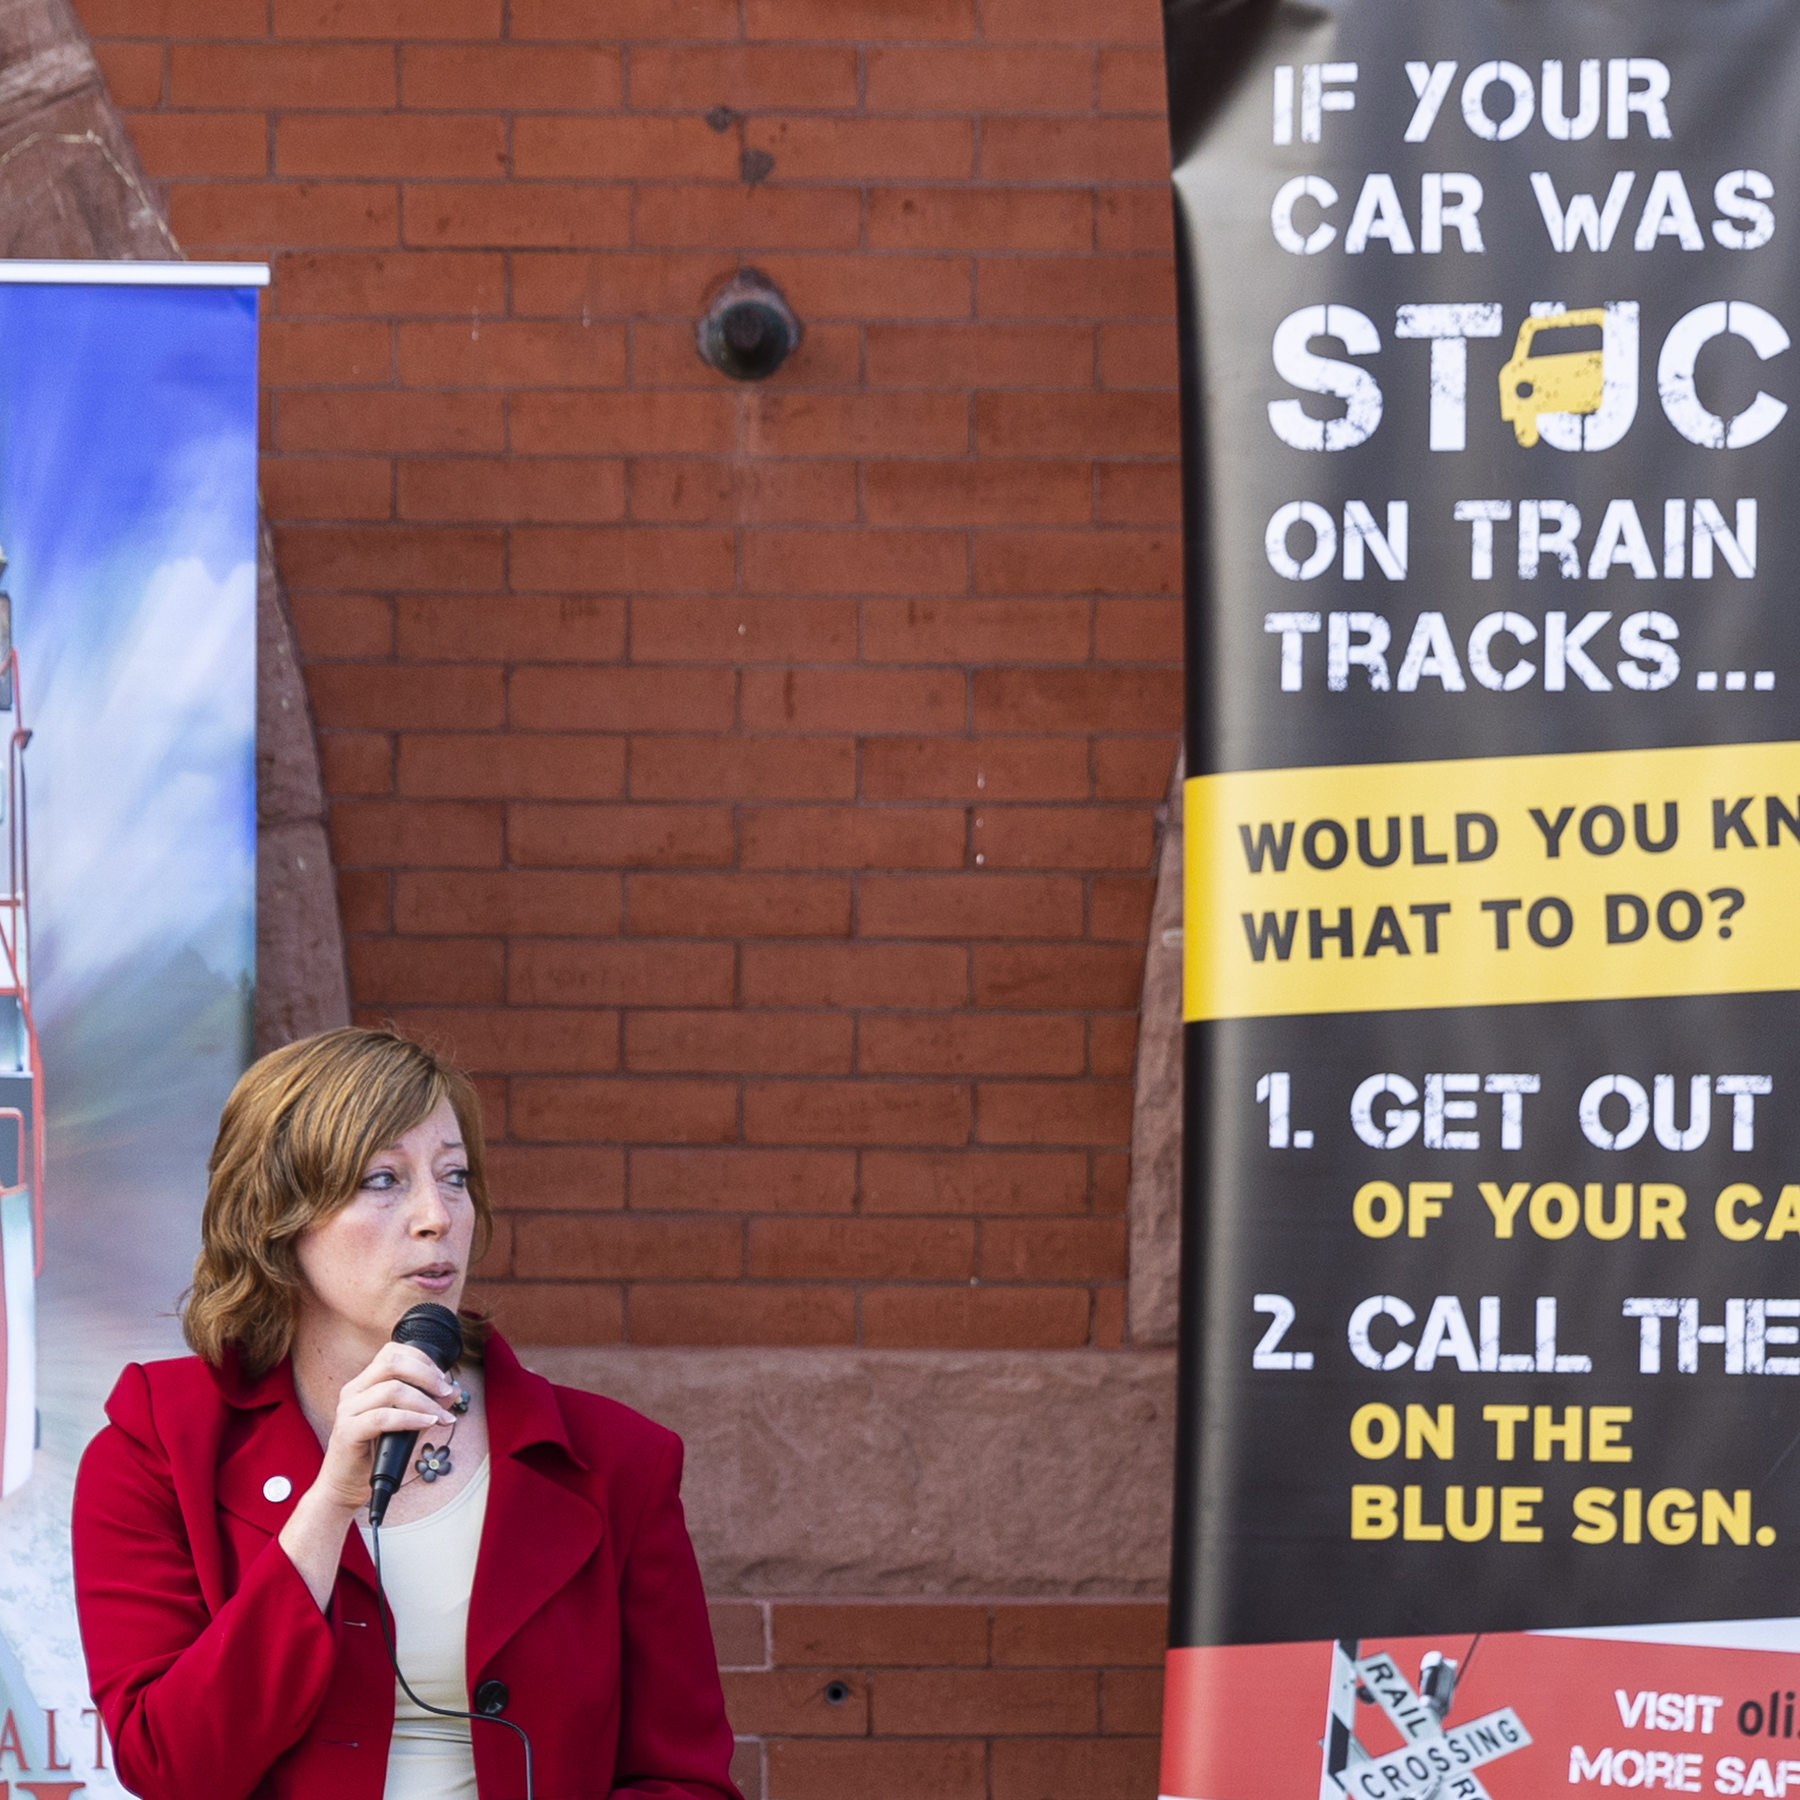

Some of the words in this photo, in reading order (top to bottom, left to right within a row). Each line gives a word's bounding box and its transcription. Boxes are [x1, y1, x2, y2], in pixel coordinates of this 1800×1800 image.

[1272, 62, 1358, 145] IF
[1404, 58, 1672, 143] YOUR
[1269, 172, 1485, 256] CAR
[1530, 168, 1777, 252] WAS
[1263, 499, 1409, 582] ON
[1454, 497, 1758, 581] TRAIN
[1263, 610, 1776, 693] TRACKS...
[1239, 808, 1500, 875] WOULD
[1528, 799, 1682, 860] YOU
[1240, 901, 1453, 964] WHAT
[1480, 895, 1575, 954] TO
[1604, 886, 1745, 947] DO?
[1254, 1070, 1314, 1150] 1.
[1349, 1072, 1541, 1151] GET
[1577, 1073, 1773, 1152] OUT
[1352, 1180, 1453, 1240] OF
[1478, 1181, 1688, 1241] YOUR
[1251, 1293, 1315, 1371] 2.
[1347, 1294, 1593, 1374] CALL
[1349, 1402, 1456, 1460] ON
[1482, 1404, 1634, 1462] THE
[1349, 1484, 1545, 1542] BLUE
[1570, 1487, 1778, 1546] SIGN.
[1365, 1660, 1429, 1740] RAIL
[1614, 1688, 1724, 1735] VISIT
[1360, 1717, 1521, 1800] CROSSING
[1568, 1744, 1704, 1793] MORE
